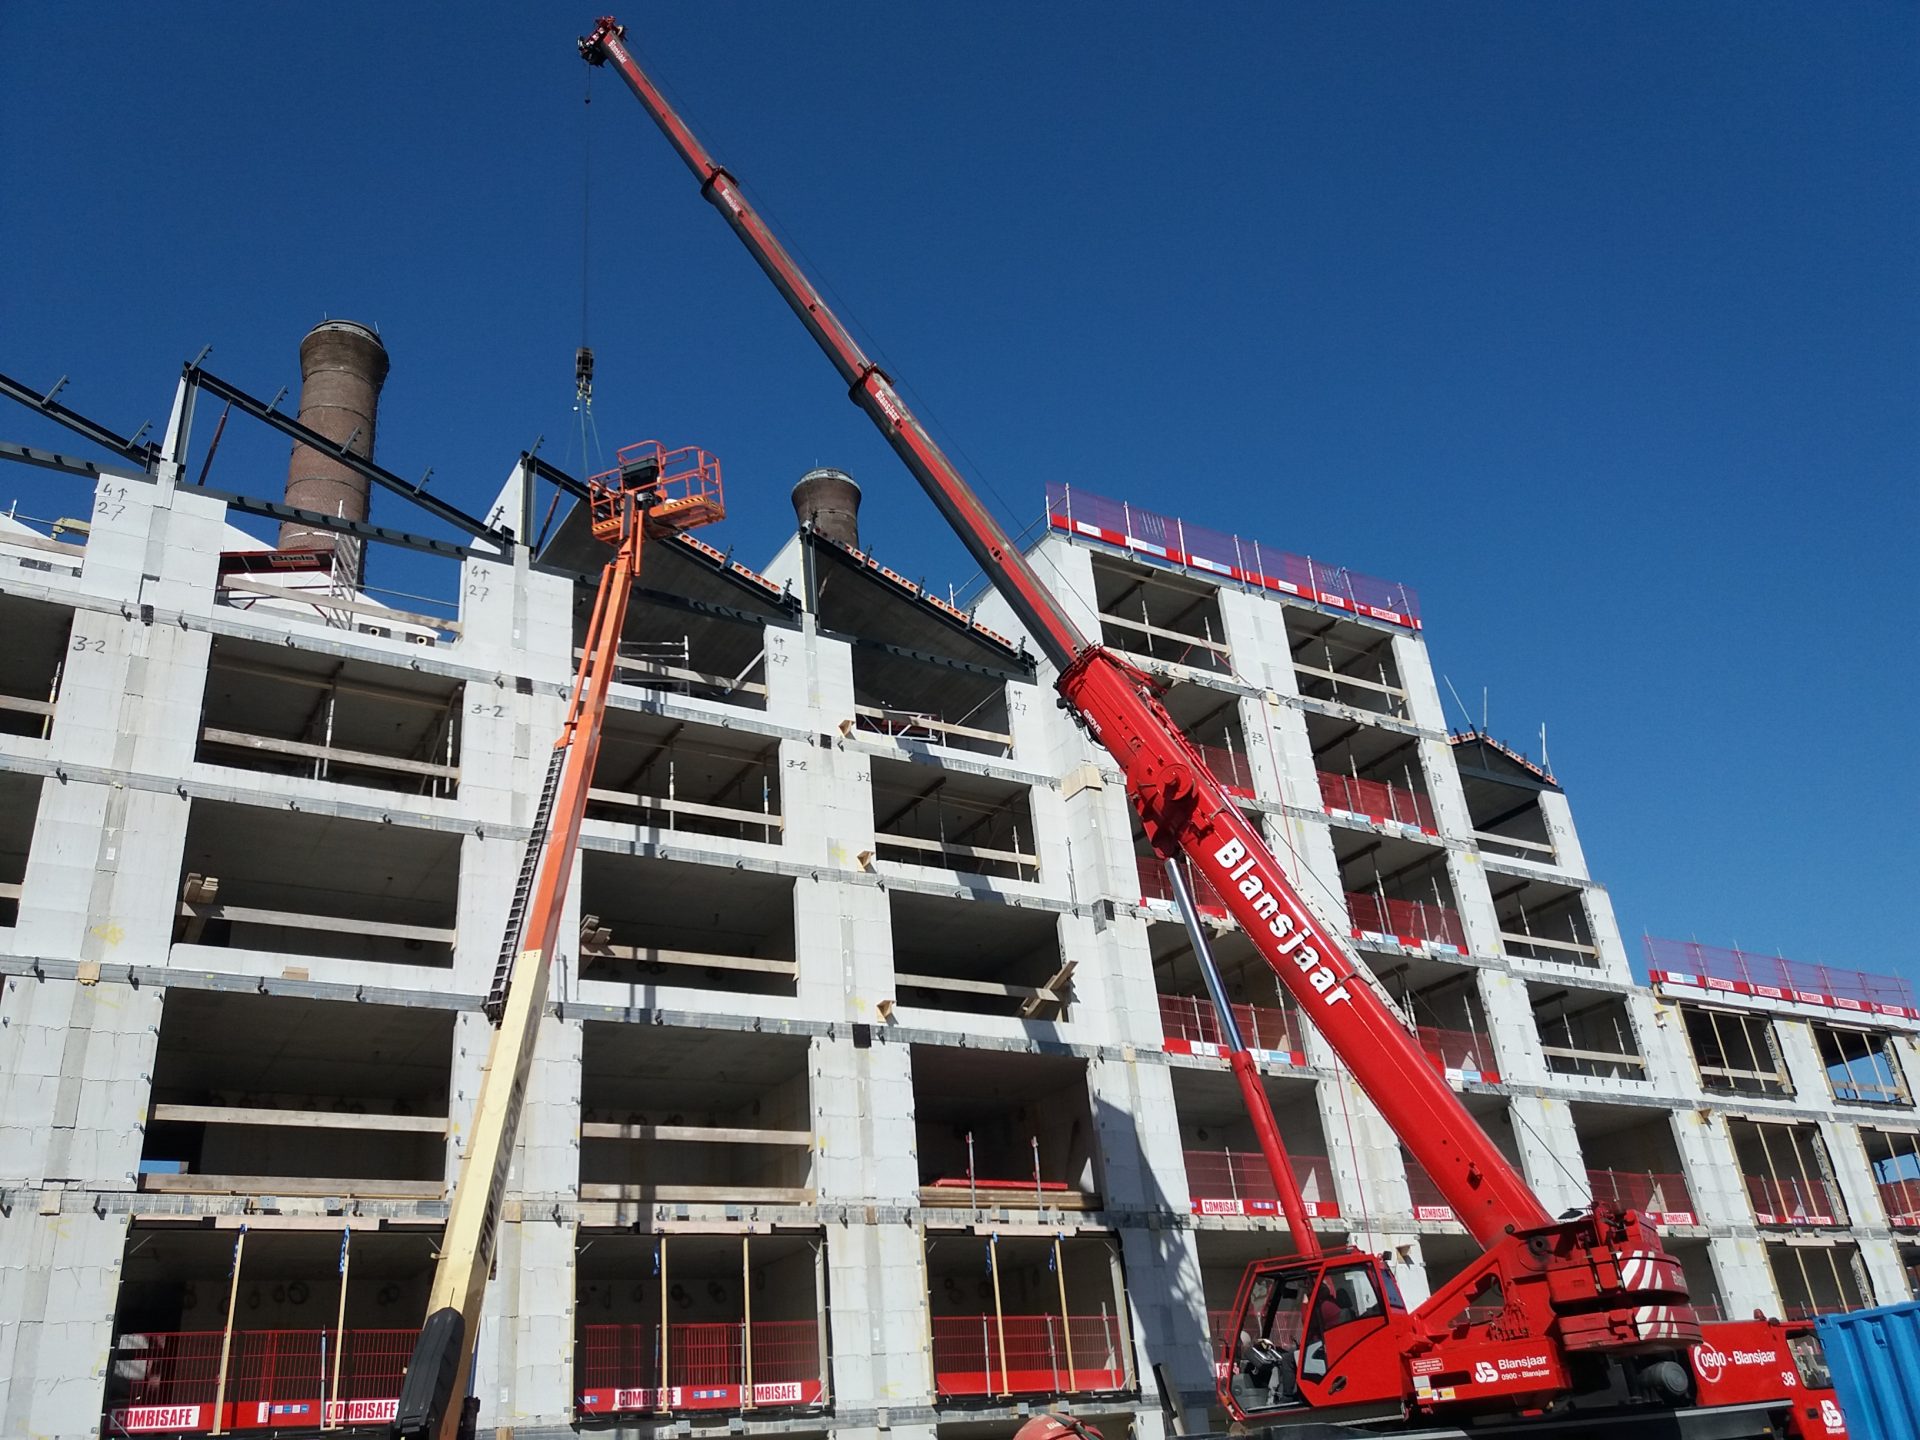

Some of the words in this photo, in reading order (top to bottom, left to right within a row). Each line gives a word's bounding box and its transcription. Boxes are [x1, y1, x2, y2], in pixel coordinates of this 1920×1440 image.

[97, 501, 126, 521] 27
[469, 584, 489, 602] 27
[73, 635, 106, 654] 3-2
[471, 703, 504, 718] 3-2
[1083, 709, 1103, 735] GROVE
[786, 760, 808, 771] 3-2
[1213, 837, 1352, 1006] Blansjaar
[1498, 1356, 1547, 1370] Blansjaar
[1701, 1351, 1727, 1367] 0900
[1732, 1349, 1777, 1366] Blansjaar
[1781, 1371, 1796, 1386] 38
[745, 1385, 796, 1401] CMBISAFE
[326, 1402, 396, 1419] COMBISAFE
